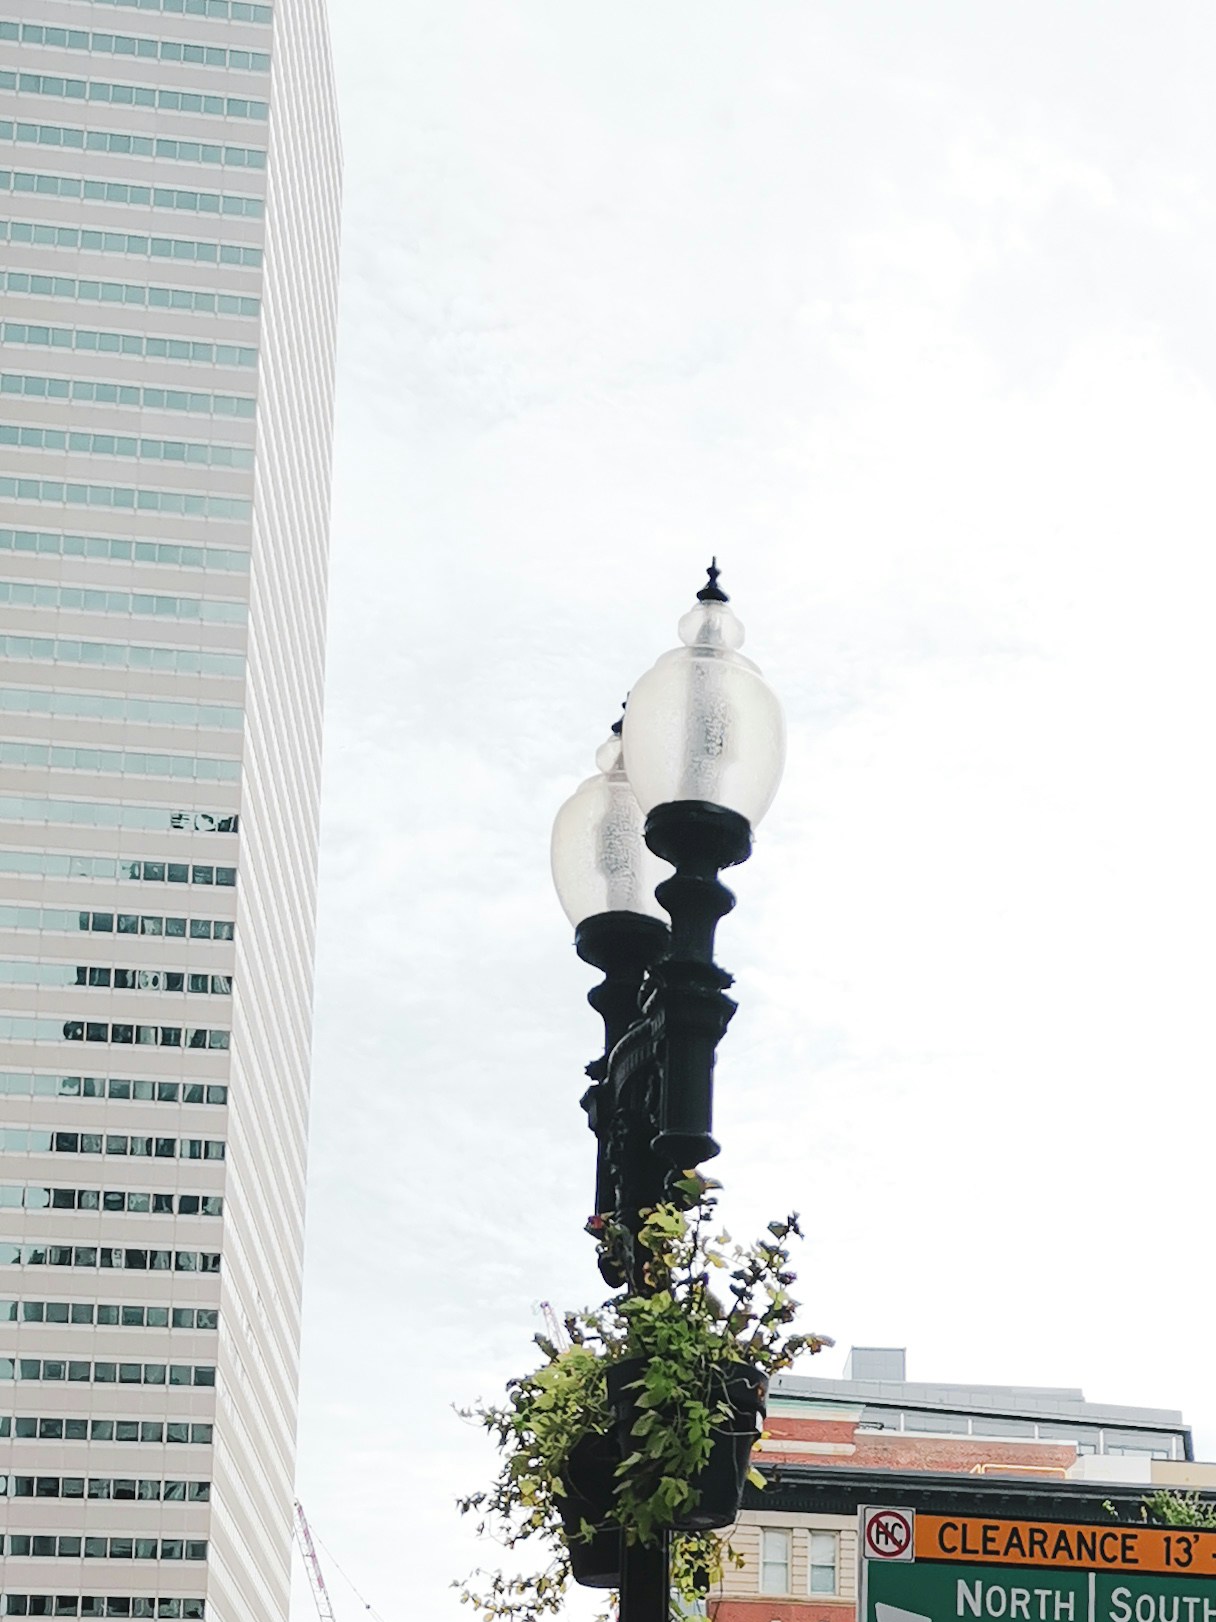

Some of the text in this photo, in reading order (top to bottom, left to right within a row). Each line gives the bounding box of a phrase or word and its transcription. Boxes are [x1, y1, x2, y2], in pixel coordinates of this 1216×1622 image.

[875, 1522, 903, 1545] HC
[938, 1521, 1139, 1563] CLEARANCE
[1163, 1534, 1199, 1568] 13'
[956, 1579, 1075, 1621] NORTH
